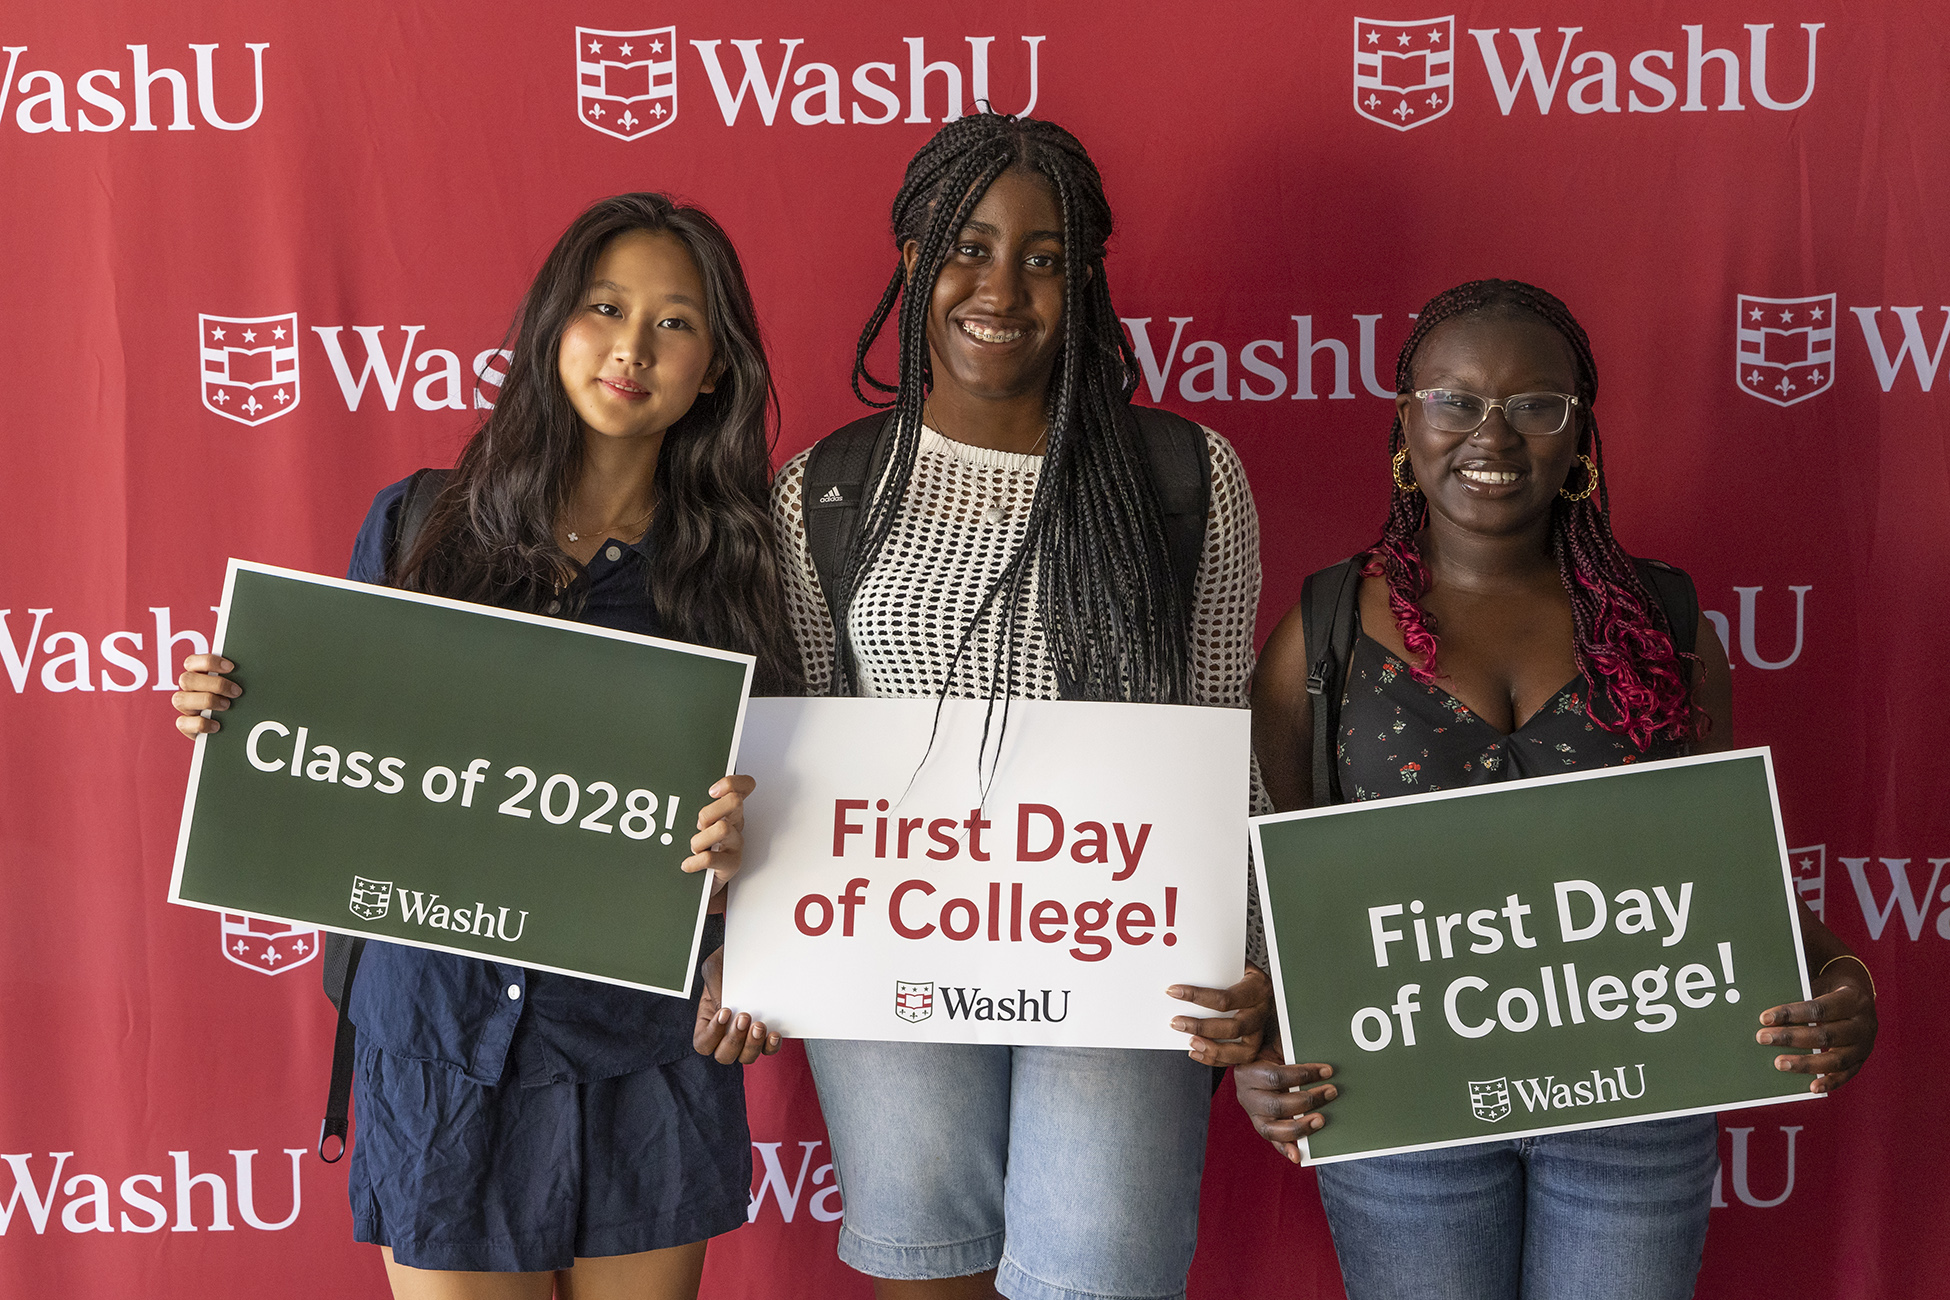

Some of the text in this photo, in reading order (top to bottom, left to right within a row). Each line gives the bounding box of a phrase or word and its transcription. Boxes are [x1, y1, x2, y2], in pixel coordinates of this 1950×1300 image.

[0, 43, 269, 133] ashU
[690, 36, 1046, 126] WashU
[1468, 23, 1825, 115] WashU
[311, 325, 515, 411] Was
[247, 721, 680, 845] Class of 2028!
[832, 799, 1152, 881] First Day
[397, 888, 529, 942] WashU
[795, 878, 1177, 962] of College!
[1368, 880, 1693, 967] First Day
[939, 987, 1071, 1022] WashU
[1351, 942, 1740, 1051] of College!
[1511, 1064, 1645, 1112] WashU
[0, 1149, 307, 1236] WashU
